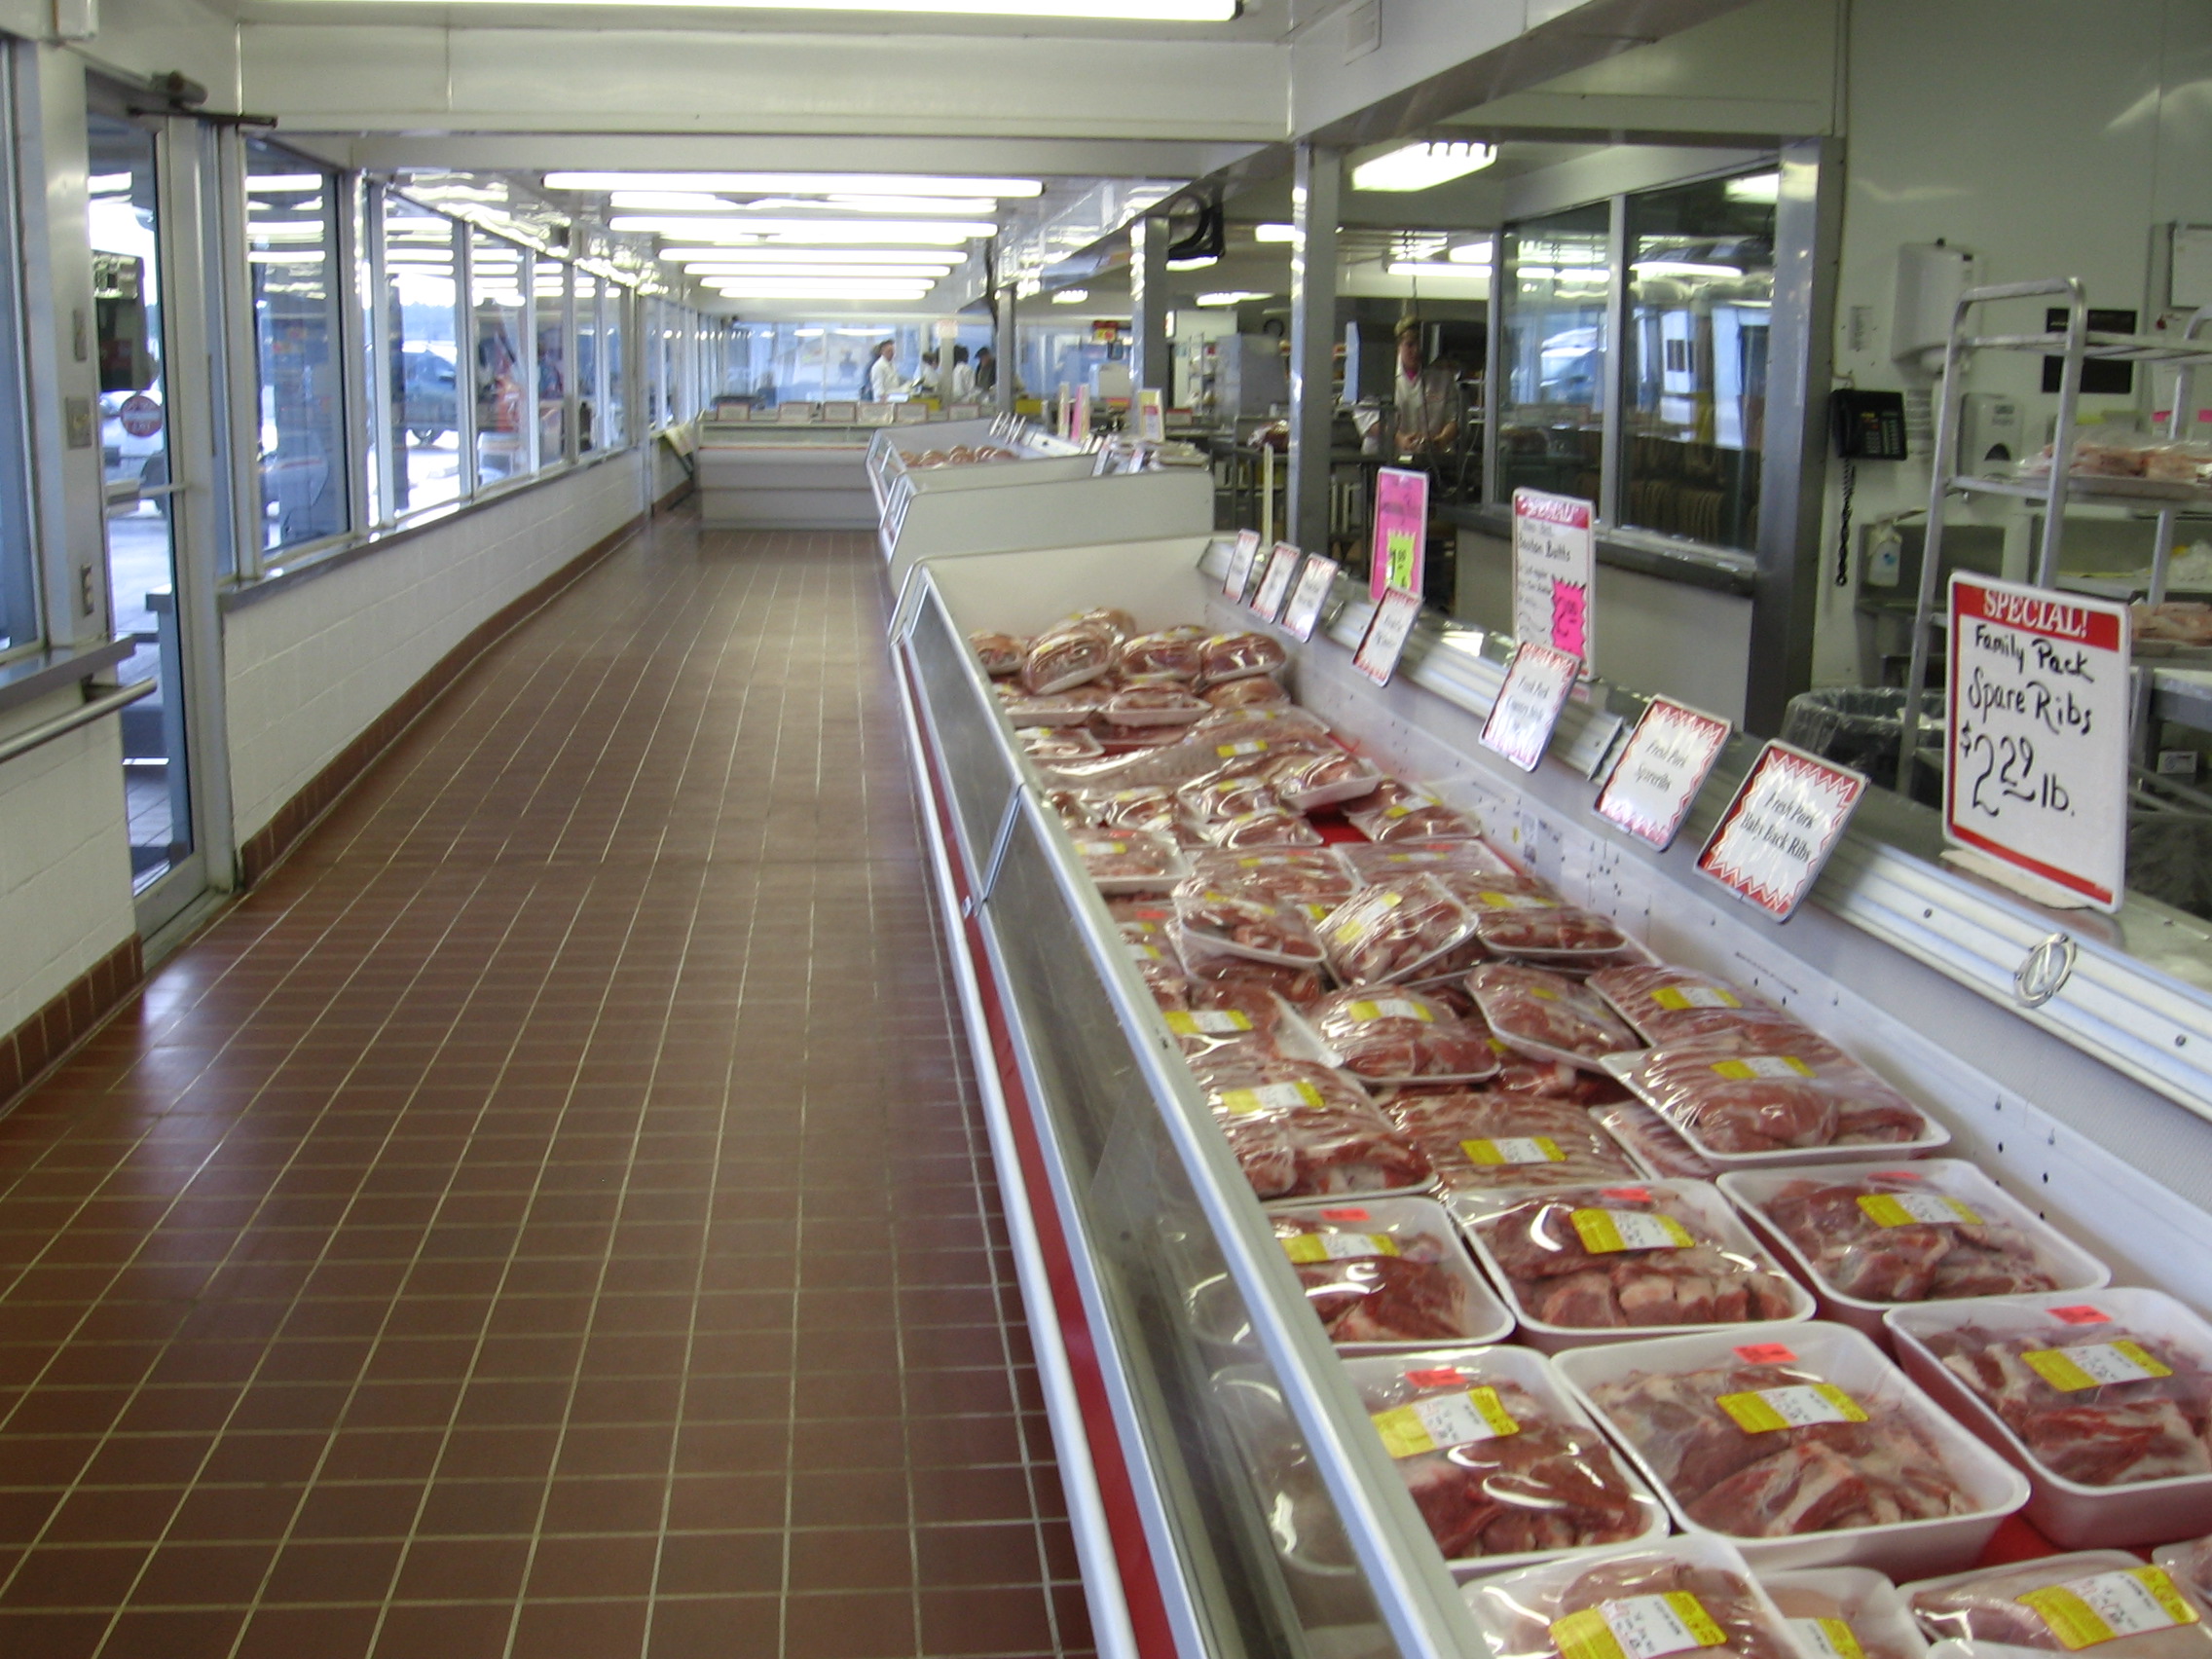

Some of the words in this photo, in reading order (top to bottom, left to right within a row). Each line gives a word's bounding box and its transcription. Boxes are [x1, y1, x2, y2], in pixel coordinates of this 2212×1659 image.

[1982, 588, 2089, 639] SPECIAL!
[1974, 624, 2025, 674] Family
[2031, 638, 2095, 682] Pack
[1968, 666, 2026, 723] Spare
[2026, 681, 2092, 735] Ribs
[1764, 791, 1794, 817] Fresh
[1790, 804, 1815, 830] Pork
[2043, 773, 2076, 817] lb.
[1740, 812, 1764, 842] Baby
[1762, 824, 1789, 850] Back
[1787, 836, 1811, 864] Ribs
